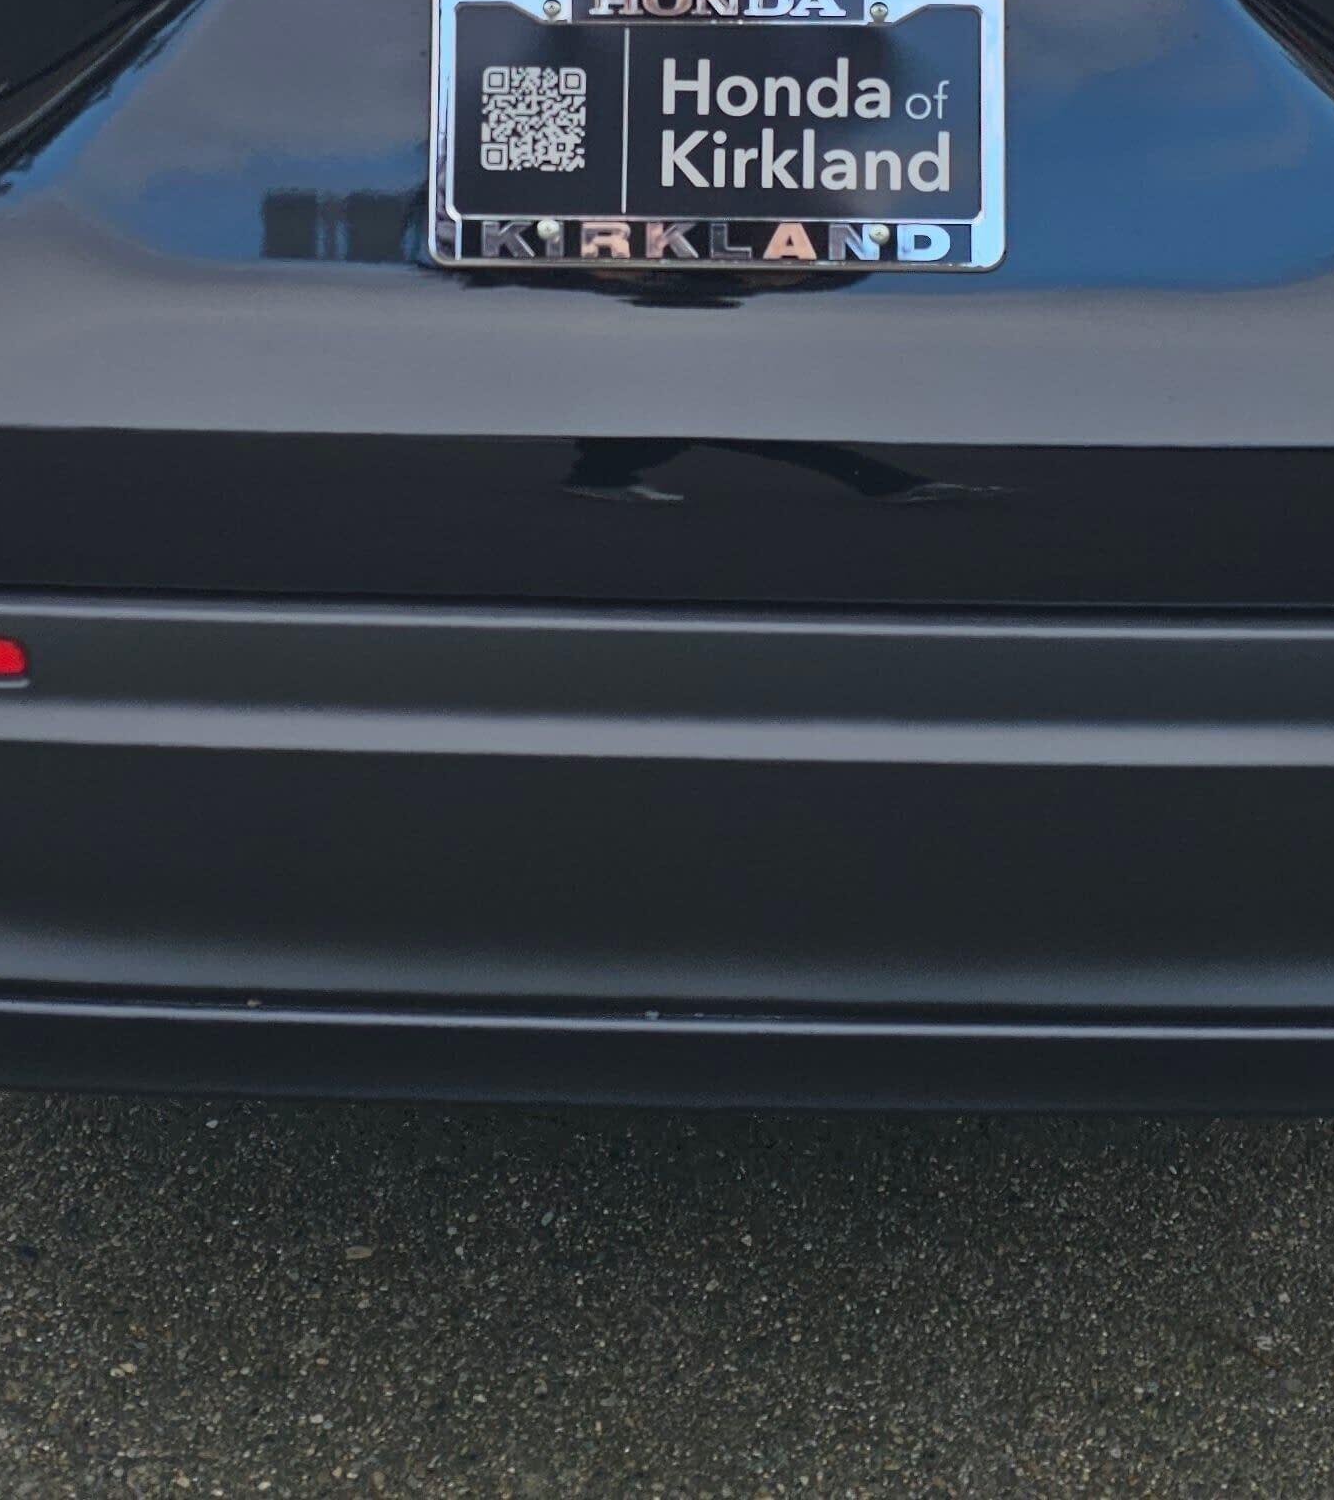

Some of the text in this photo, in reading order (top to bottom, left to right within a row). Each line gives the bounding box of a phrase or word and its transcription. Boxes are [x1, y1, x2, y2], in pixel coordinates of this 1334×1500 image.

[661, 56, 949, 121] Honda of
[660, 126, 951, 193] Kirkland
[480, 219, 951, 262] KIRKLAND
